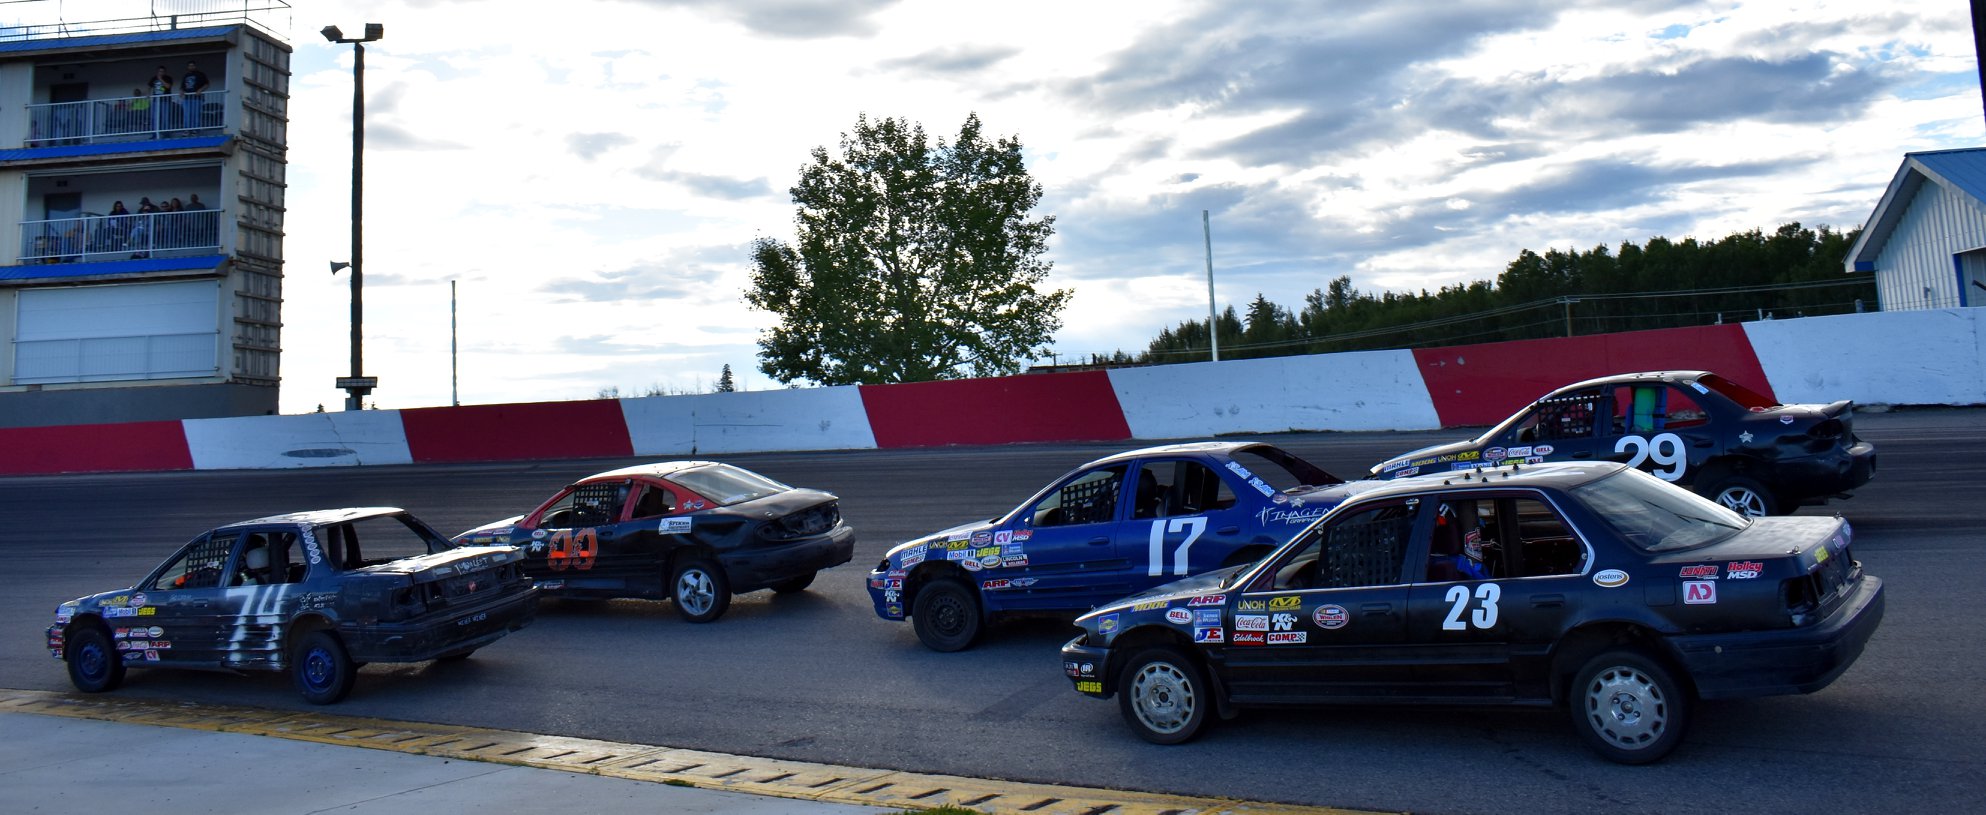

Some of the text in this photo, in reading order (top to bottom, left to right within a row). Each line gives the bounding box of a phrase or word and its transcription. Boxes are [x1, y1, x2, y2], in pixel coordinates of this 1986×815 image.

[1614, 432, 1687, 482] 29
[995, 533, 1011, 543] CV
[1148, 516, 1208, 576] 17
[976, 547, 1001, 557] JEGS
[1727, 561, 1764, 572] Holley
[1595, 573, 1624, 581] jostens
[1727, 571, 1759, 580] MSD
[983, 579, 1010, 588] ARP
[1188, 595, 1226, 604] ARP
[1237, 599, 1266, 609] UNOH
[1133, 601, 1169, 611] MOOG
[1442, 582, 1501, 630] 23
[1169, 611, 1190, 620] BELL
[225, 584, 290, 664] 74
[1196, 628, 1222, 641] JE
[1233, 633, 1265, 642] Edelbrock
[1268, 633, 1297, 642] COMP
[1077, 681, 1102, 692] JEGS
